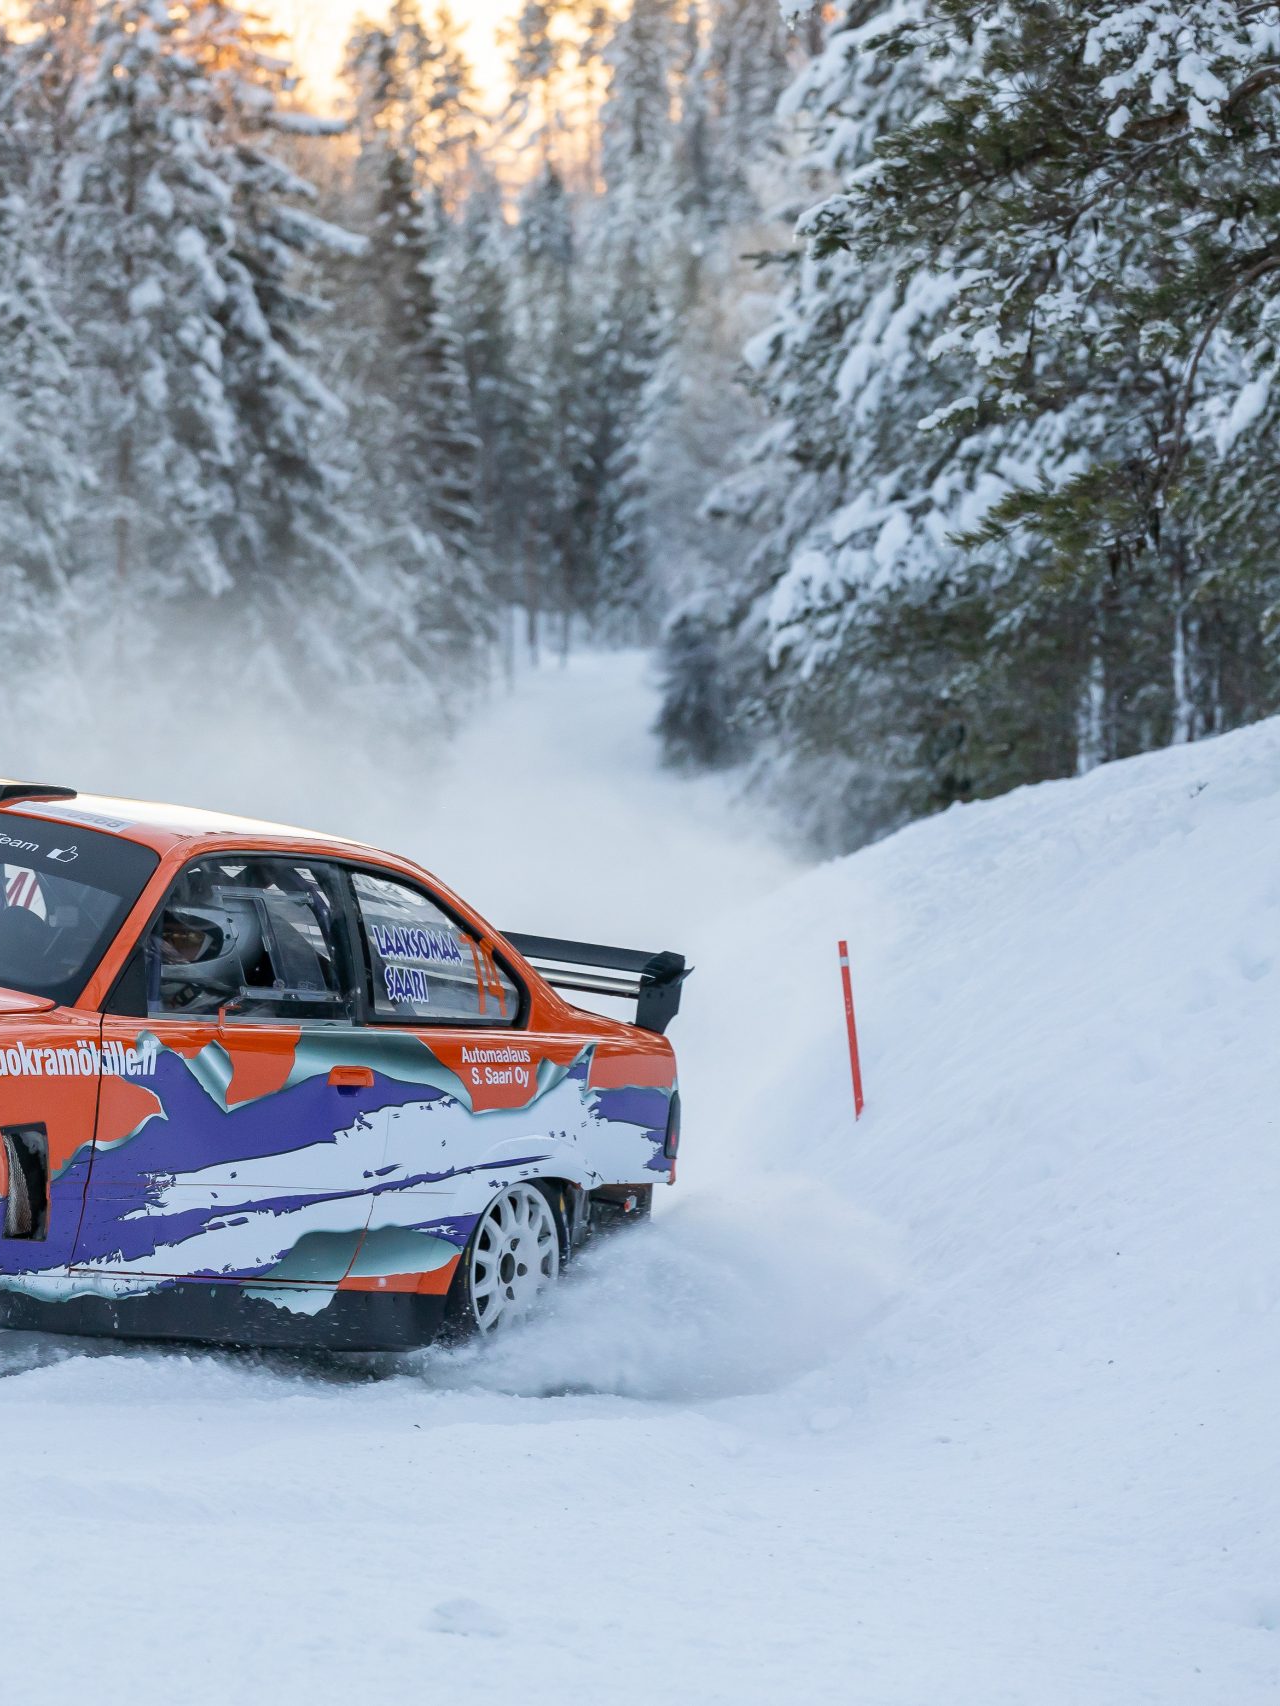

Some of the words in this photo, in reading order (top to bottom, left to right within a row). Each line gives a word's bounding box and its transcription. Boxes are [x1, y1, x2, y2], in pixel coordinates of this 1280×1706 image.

[371, 925, 463, 966] LAAKSOMAA
[384, 965, 429, 1003] SAARI
[461, 1046, 531, 1063] Automaalaus
[471, 1066, 483, 1085] S.
[485, 1066, 513, 1085] Saari
[515, 1066, 529, 1088] Oy
